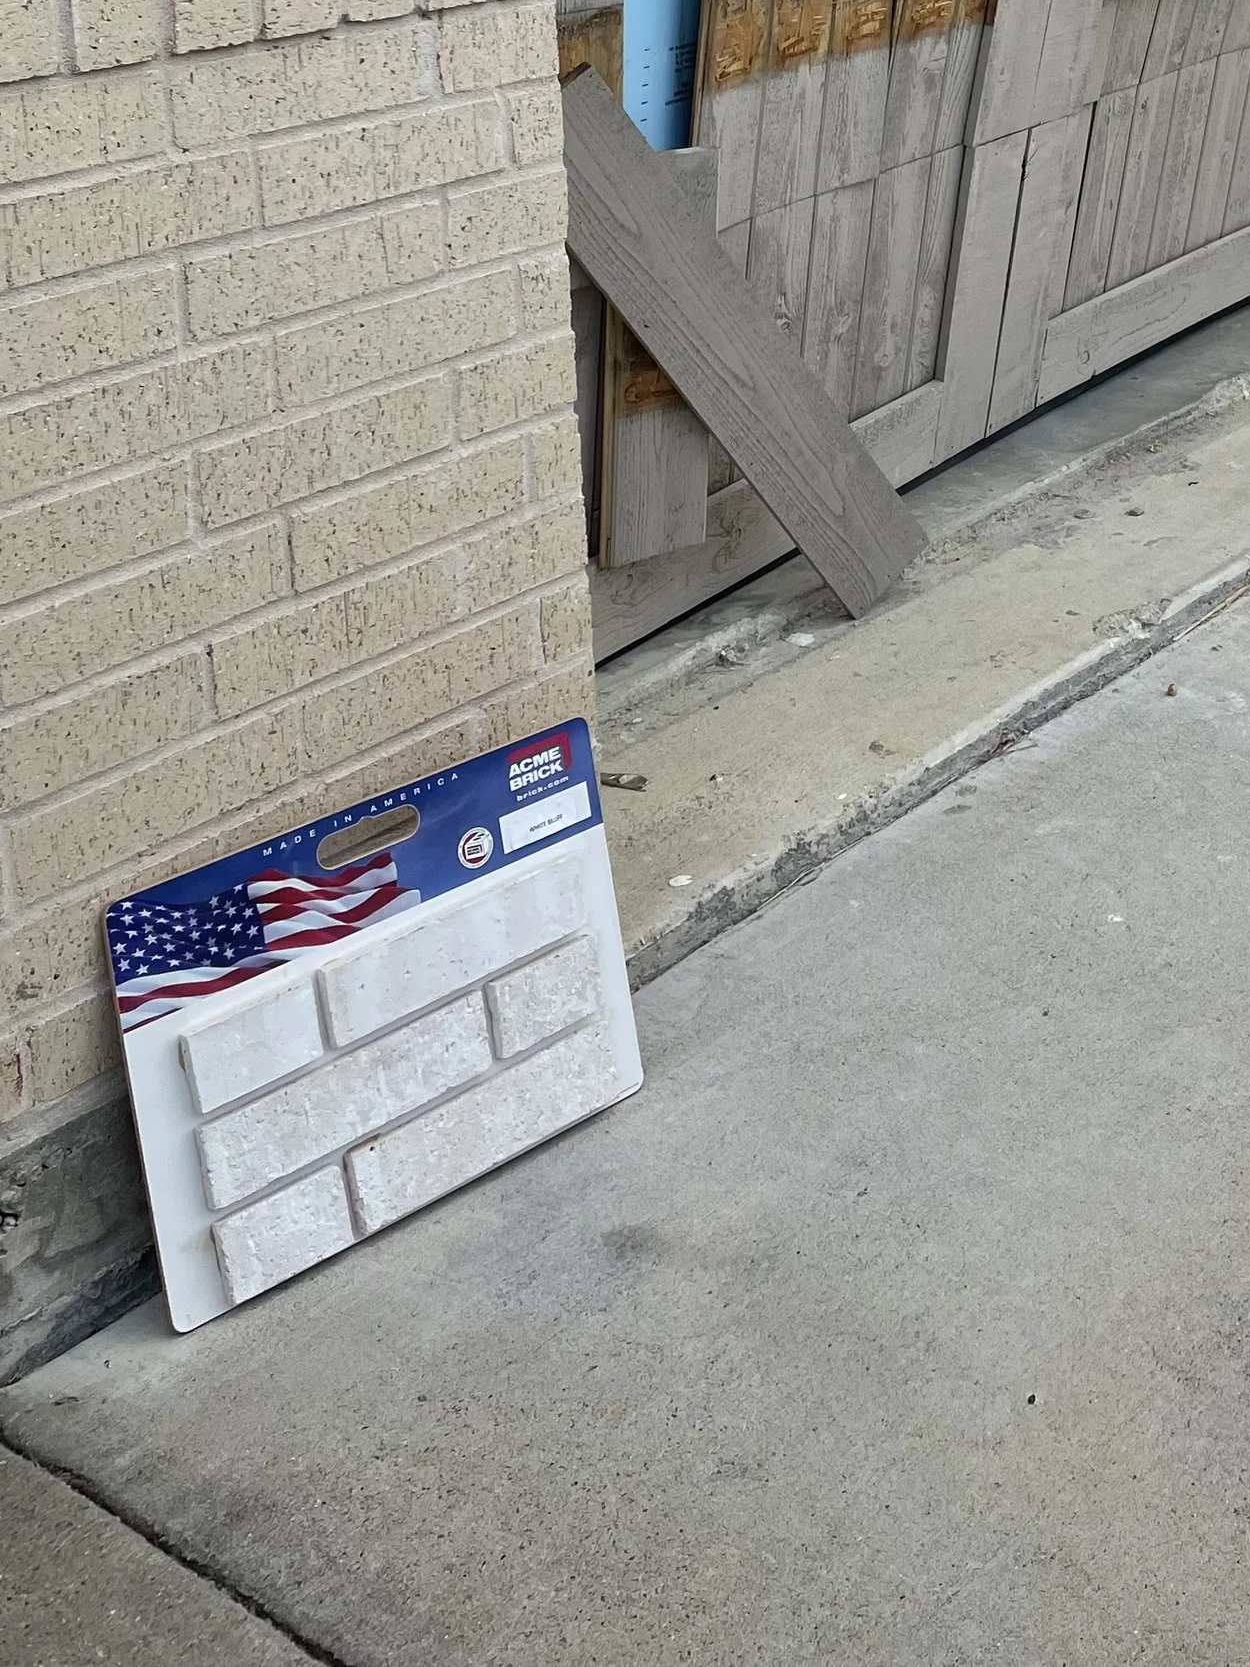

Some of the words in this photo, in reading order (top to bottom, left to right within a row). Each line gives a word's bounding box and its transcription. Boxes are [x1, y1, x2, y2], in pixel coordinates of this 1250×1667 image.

[508, 746, 562, 778] ACME
[509, 759, 563, 792] BRICK
[516, 776, 569, 802] brick.com
[262, 828, 316, 857] MADE
[333, 814, 352, 828] IN
[369, 772, 459, 814] AMERICA
